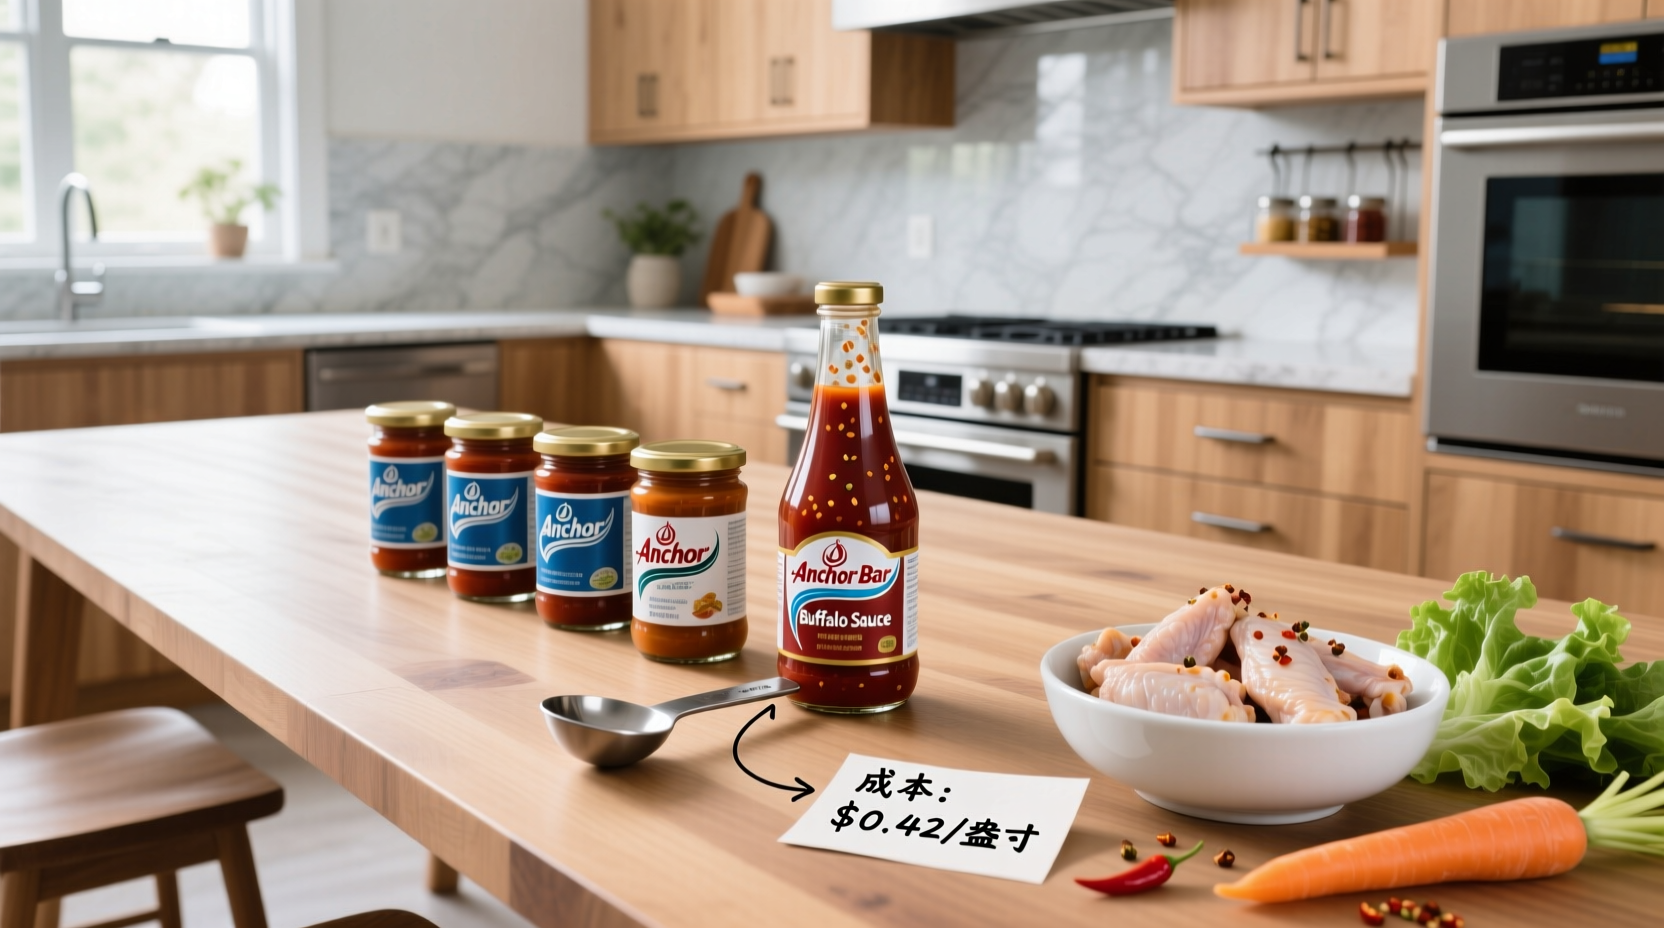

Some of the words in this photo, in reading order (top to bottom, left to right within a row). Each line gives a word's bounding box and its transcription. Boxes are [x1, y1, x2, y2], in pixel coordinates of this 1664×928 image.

[372, 477, 429, 498] Anchor
[452, 493, 511, 516] Anchor
[541, 514, 606, 539] Anchor
[636, 537, 710, 565] Anchor
[791, 561, 858, 585] Anchor
[858, 564, 892, 584] Bar
[799, 609, 848, 628] Buffalo
[850, 611, 892, 628] Sauce
[855, 767, 951, 803] 成本：
